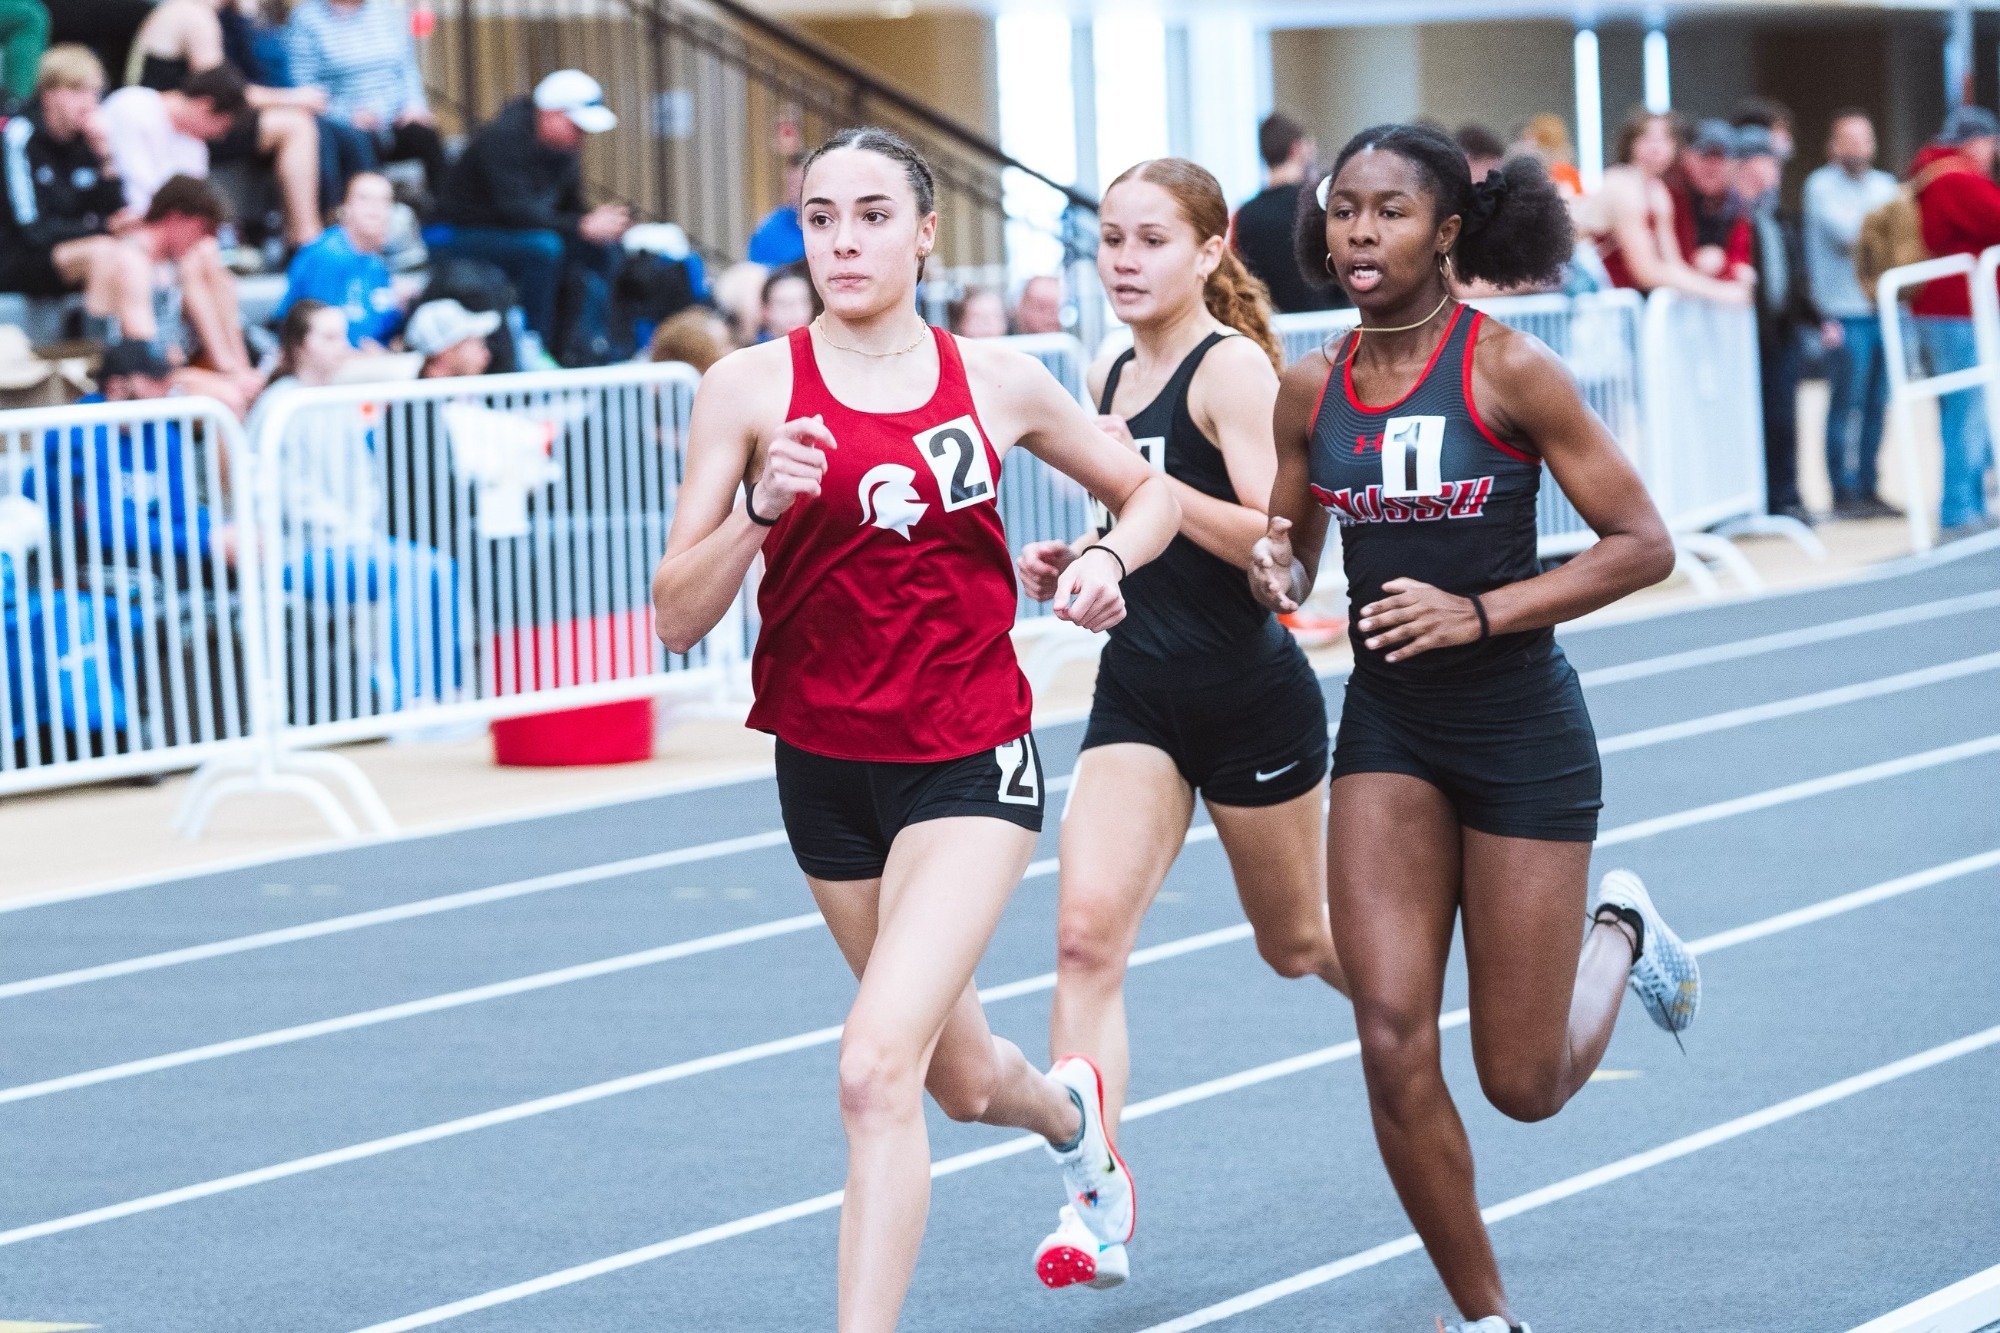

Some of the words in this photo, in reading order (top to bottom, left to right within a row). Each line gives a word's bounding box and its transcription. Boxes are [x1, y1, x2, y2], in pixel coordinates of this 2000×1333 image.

[929, 428, 988, 504] 2
[1394, 422, 1420, 490] 1
[1002, 736, 1034, 798] 2
